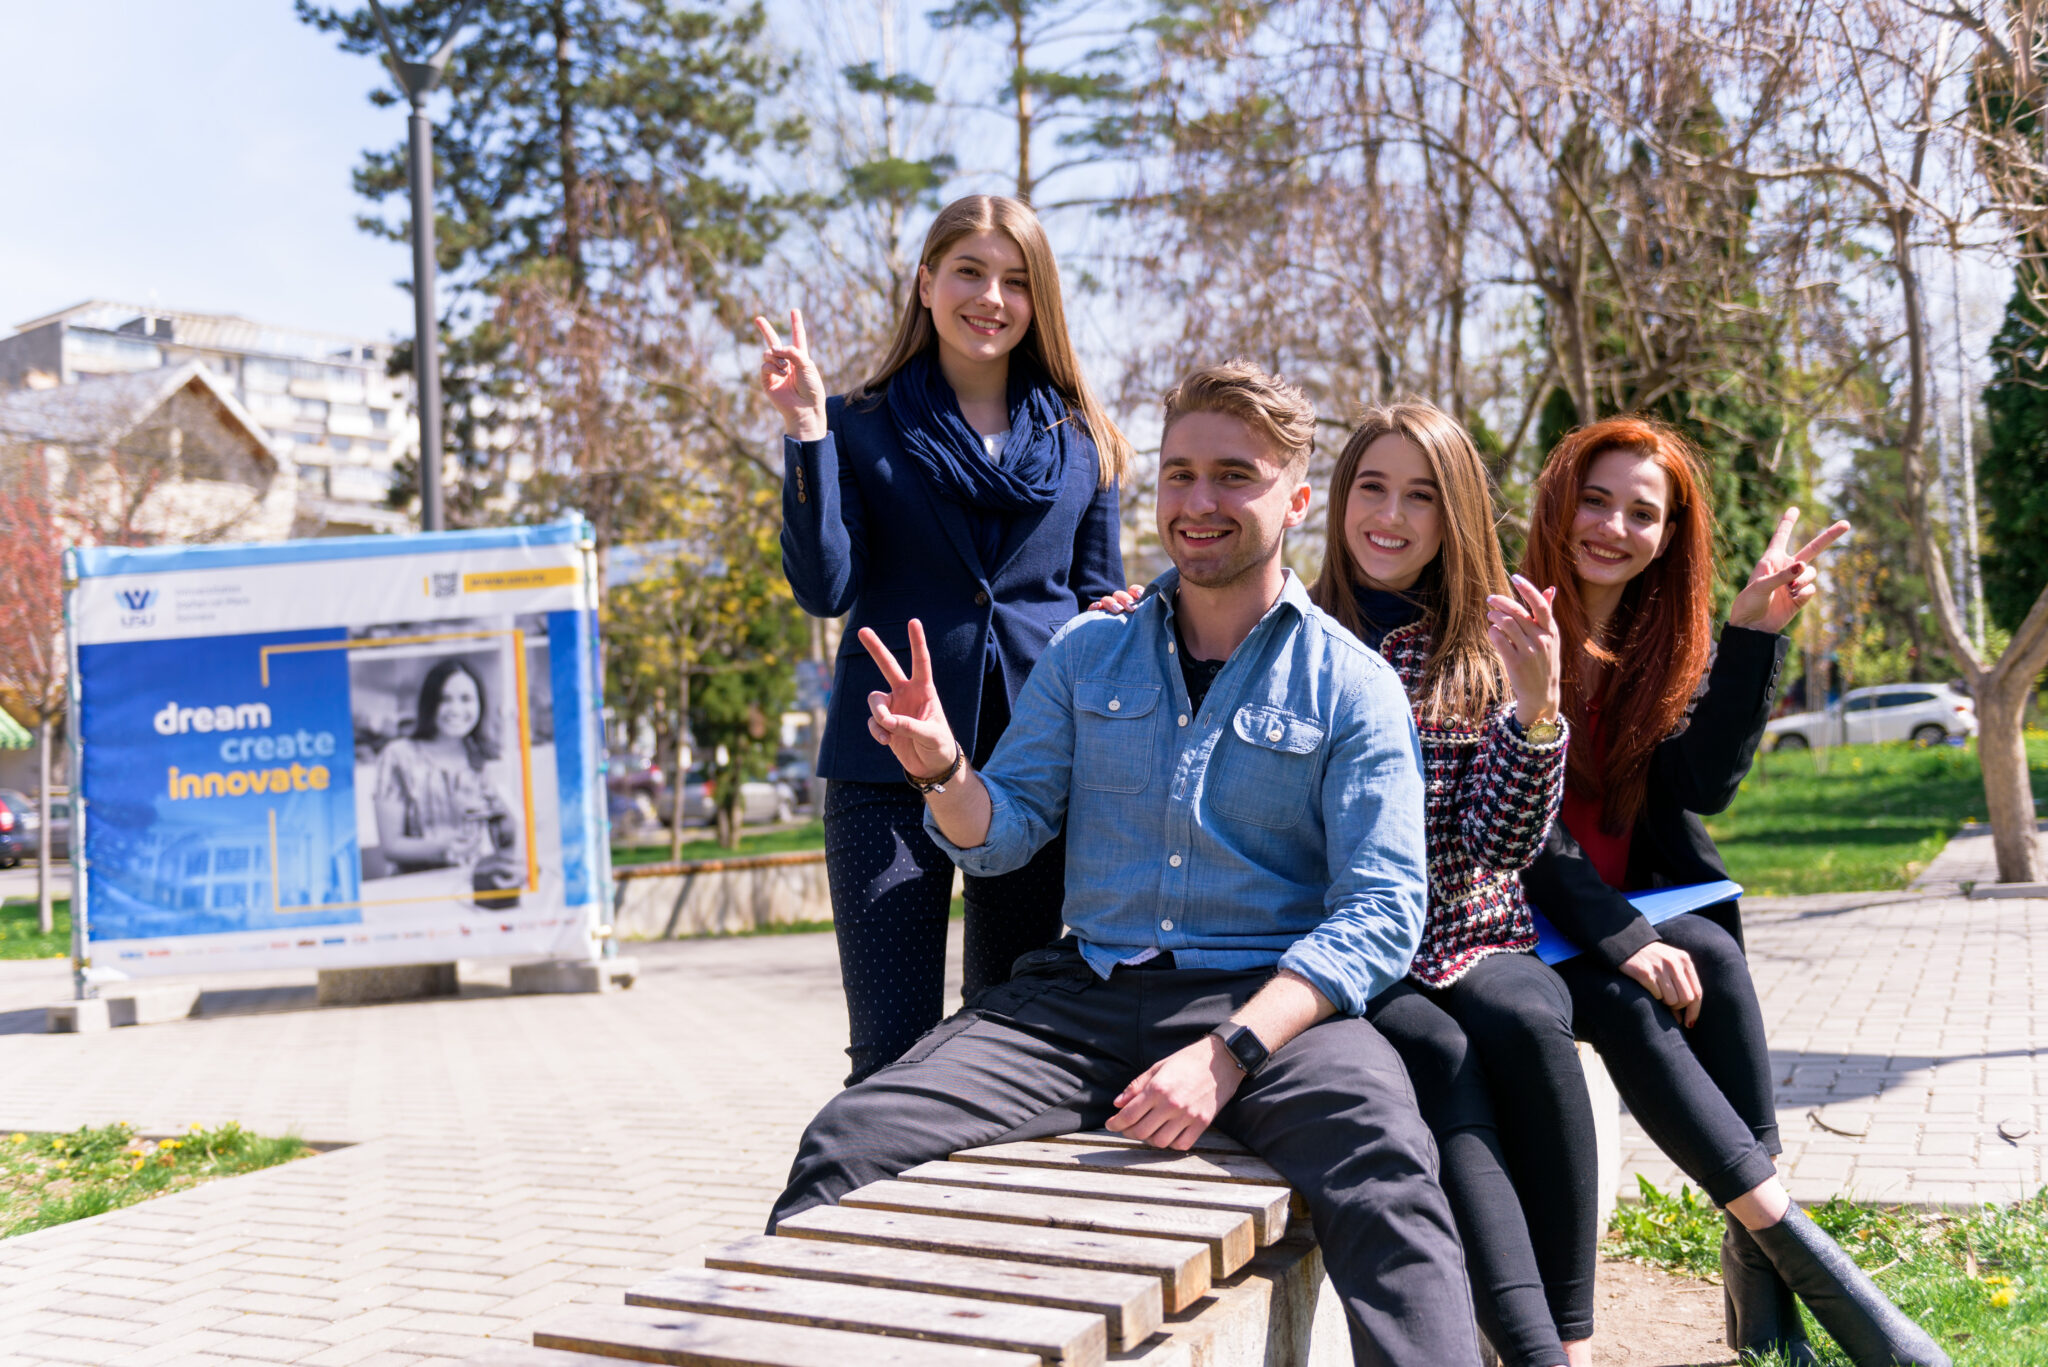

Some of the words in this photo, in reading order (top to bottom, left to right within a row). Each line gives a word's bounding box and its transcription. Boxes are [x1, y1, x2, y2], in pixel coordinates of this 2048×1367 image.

[154, 702, 271, 735] dream
[220, 729, 336, 763] create
[168, 762, 330, 800] innovate
